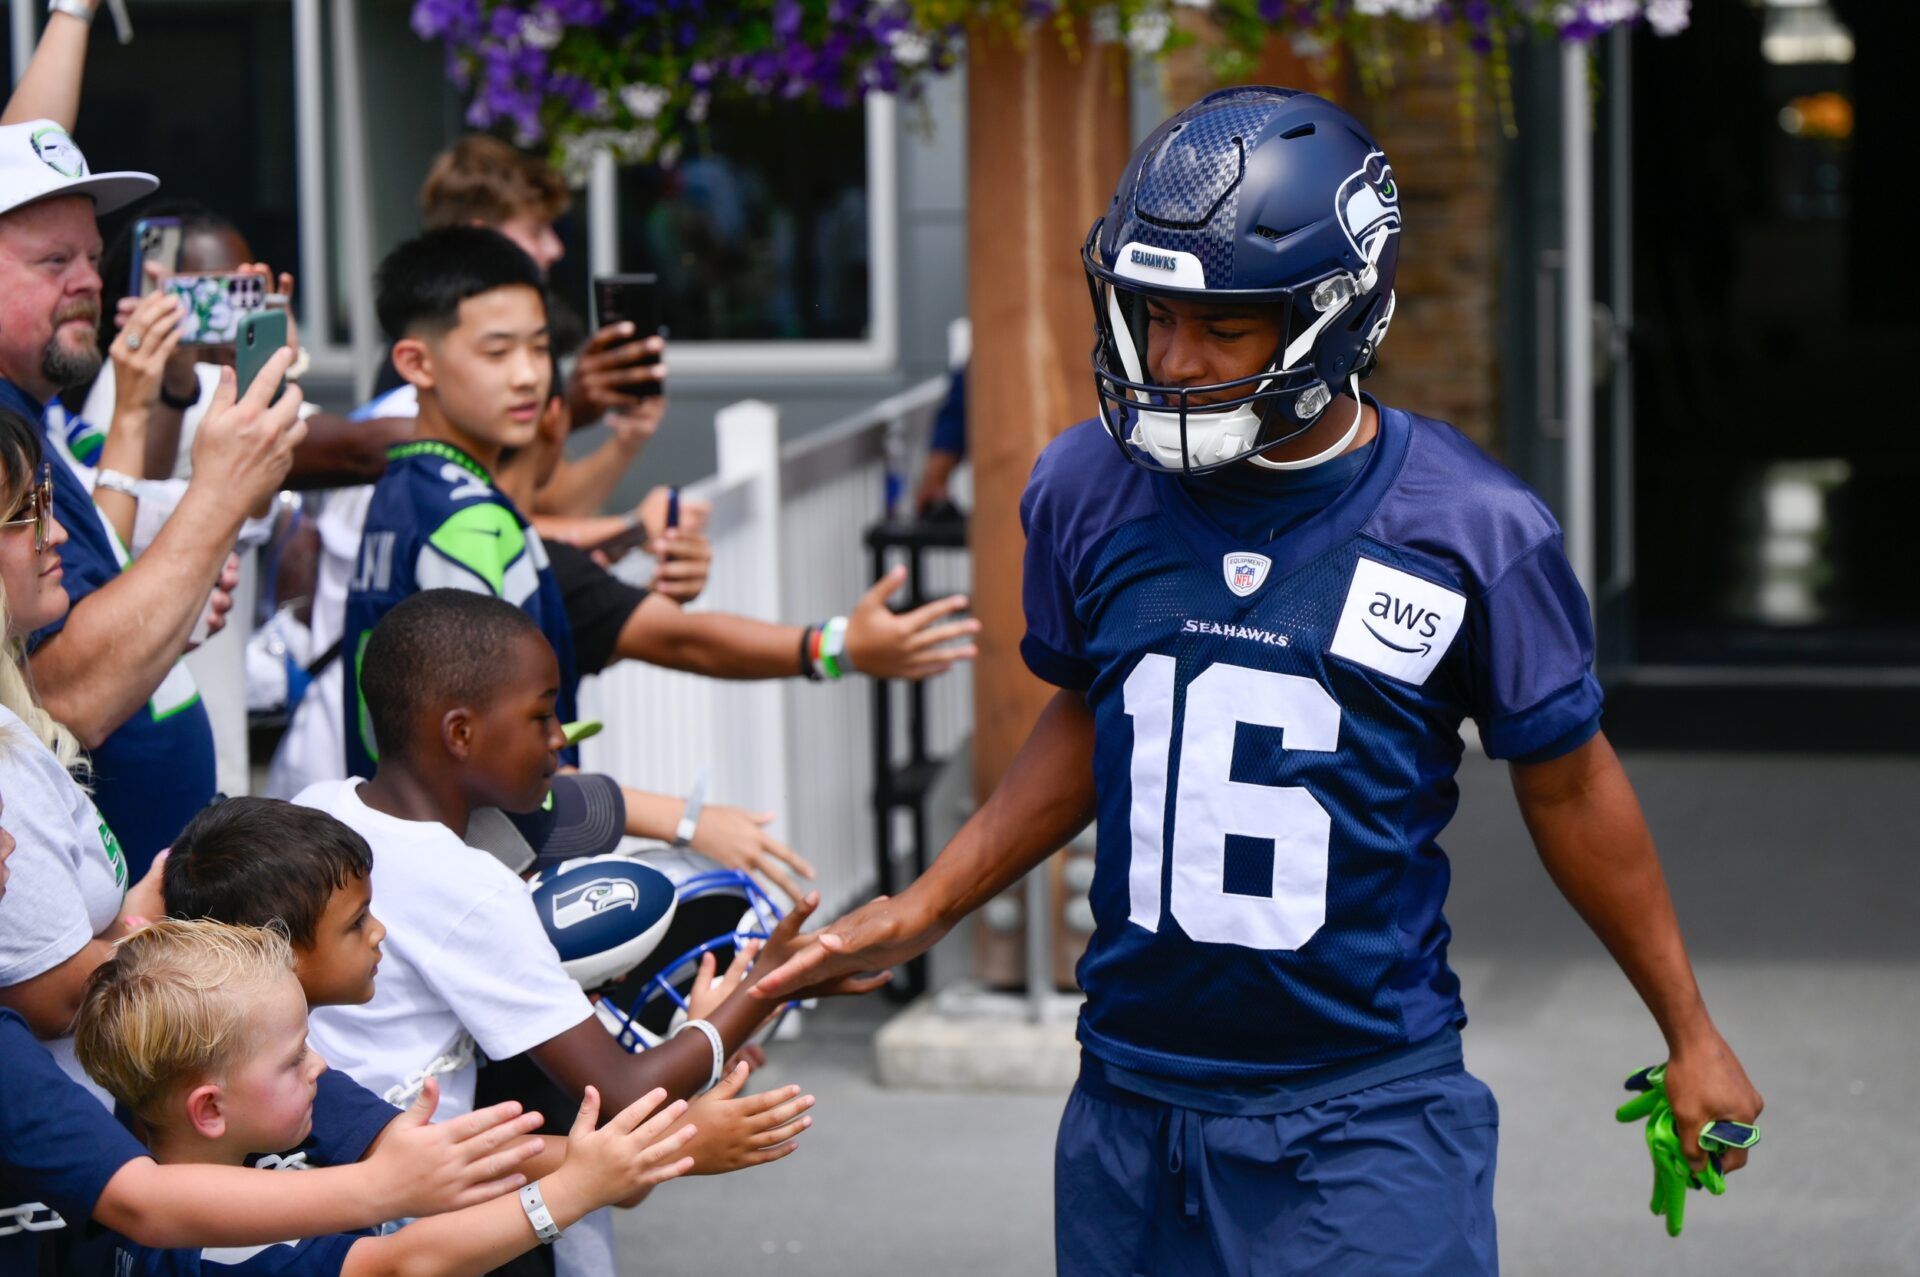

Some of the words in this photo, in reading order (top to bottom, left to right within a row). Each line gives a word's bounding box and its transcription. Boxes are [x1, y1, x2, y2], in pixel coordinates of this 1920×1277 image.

[1130, 249, 1177, 271] SEAHAWKS
[1229, 558, 1265, 568] EQUIPMENT
[1235, 574, 1253, 587] NFL
[1368, 591, 1441, 638] aws
[1181, 619, 1290, 648] SEAHAWKS
[1123, 652, 1342, 952] 16
